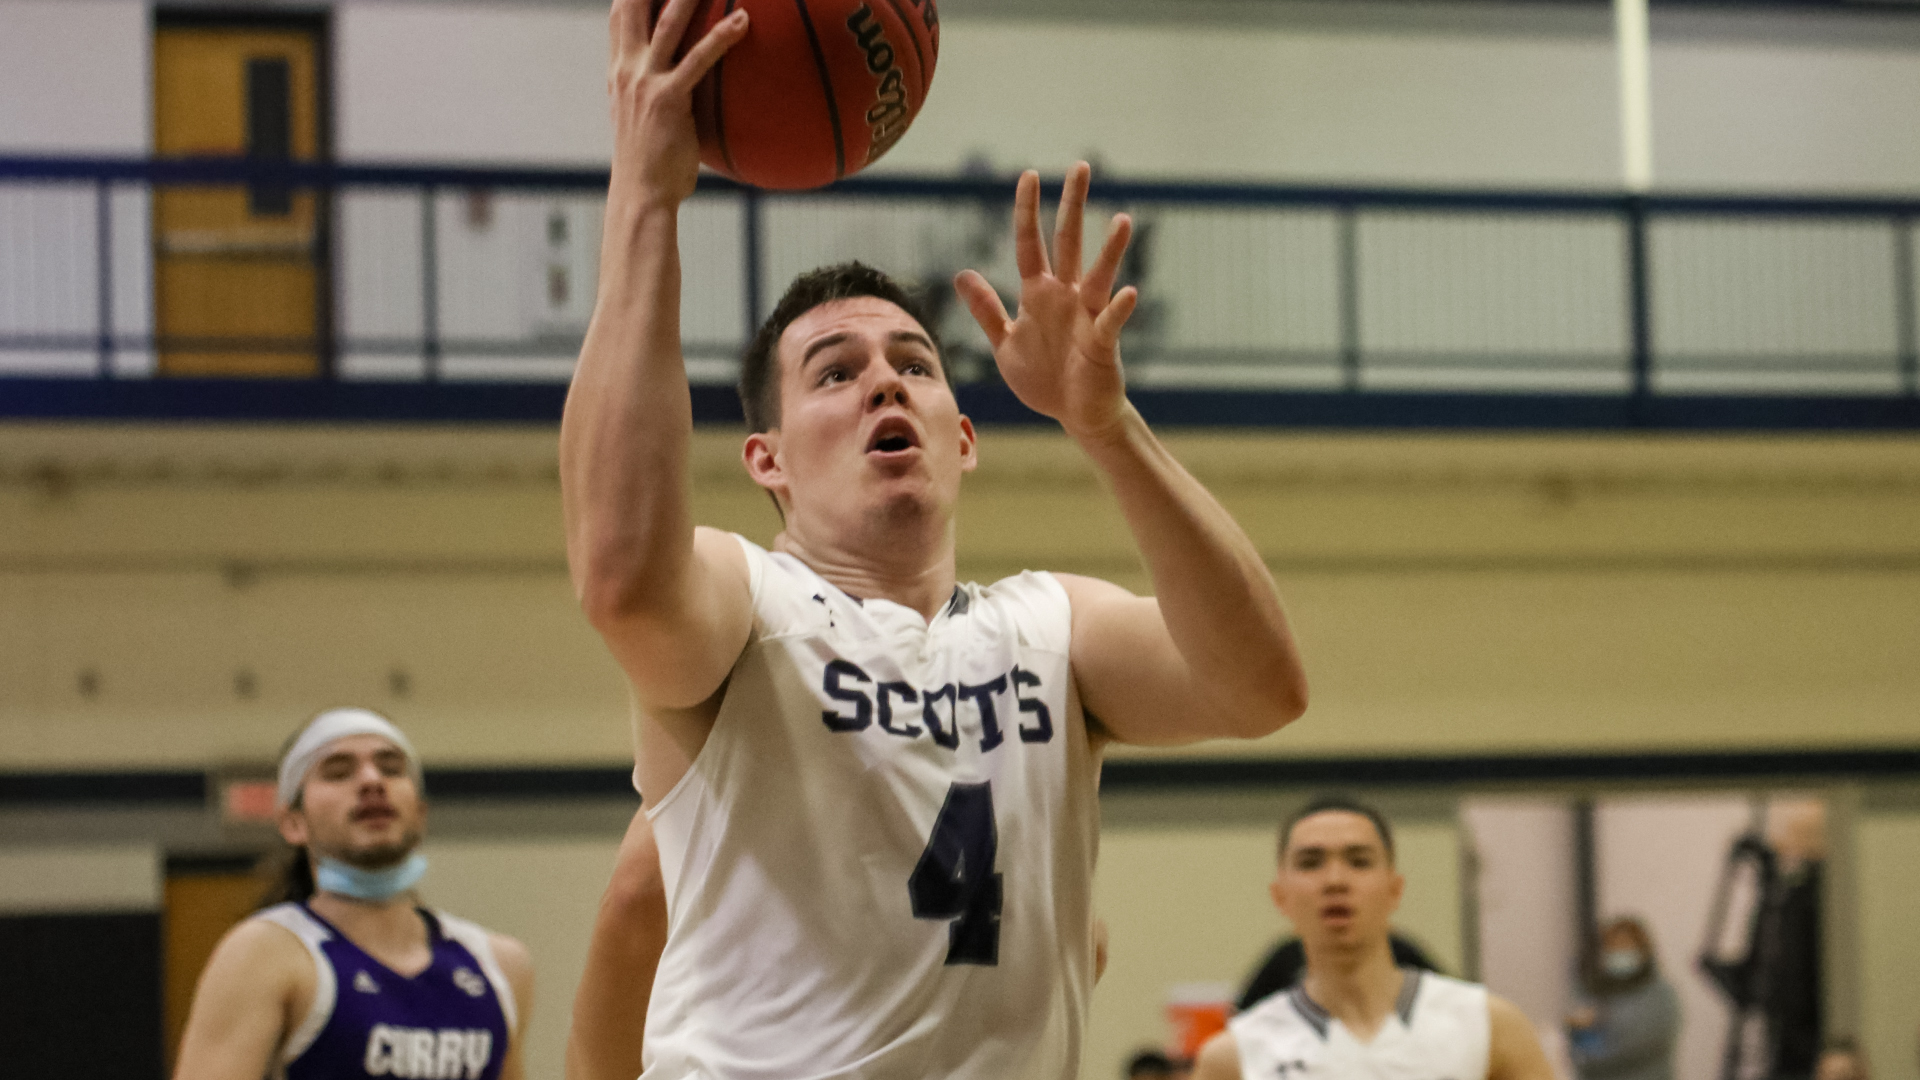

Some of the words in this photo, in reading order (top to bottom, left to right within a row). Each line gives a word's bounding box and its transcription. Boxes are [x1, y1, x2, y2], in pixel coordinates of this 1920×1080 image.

[822, 658, 1054, 753] SCOTS
[908, 779, 1003, 966] 4
[365, 1023, 493, 1080] CURRY
